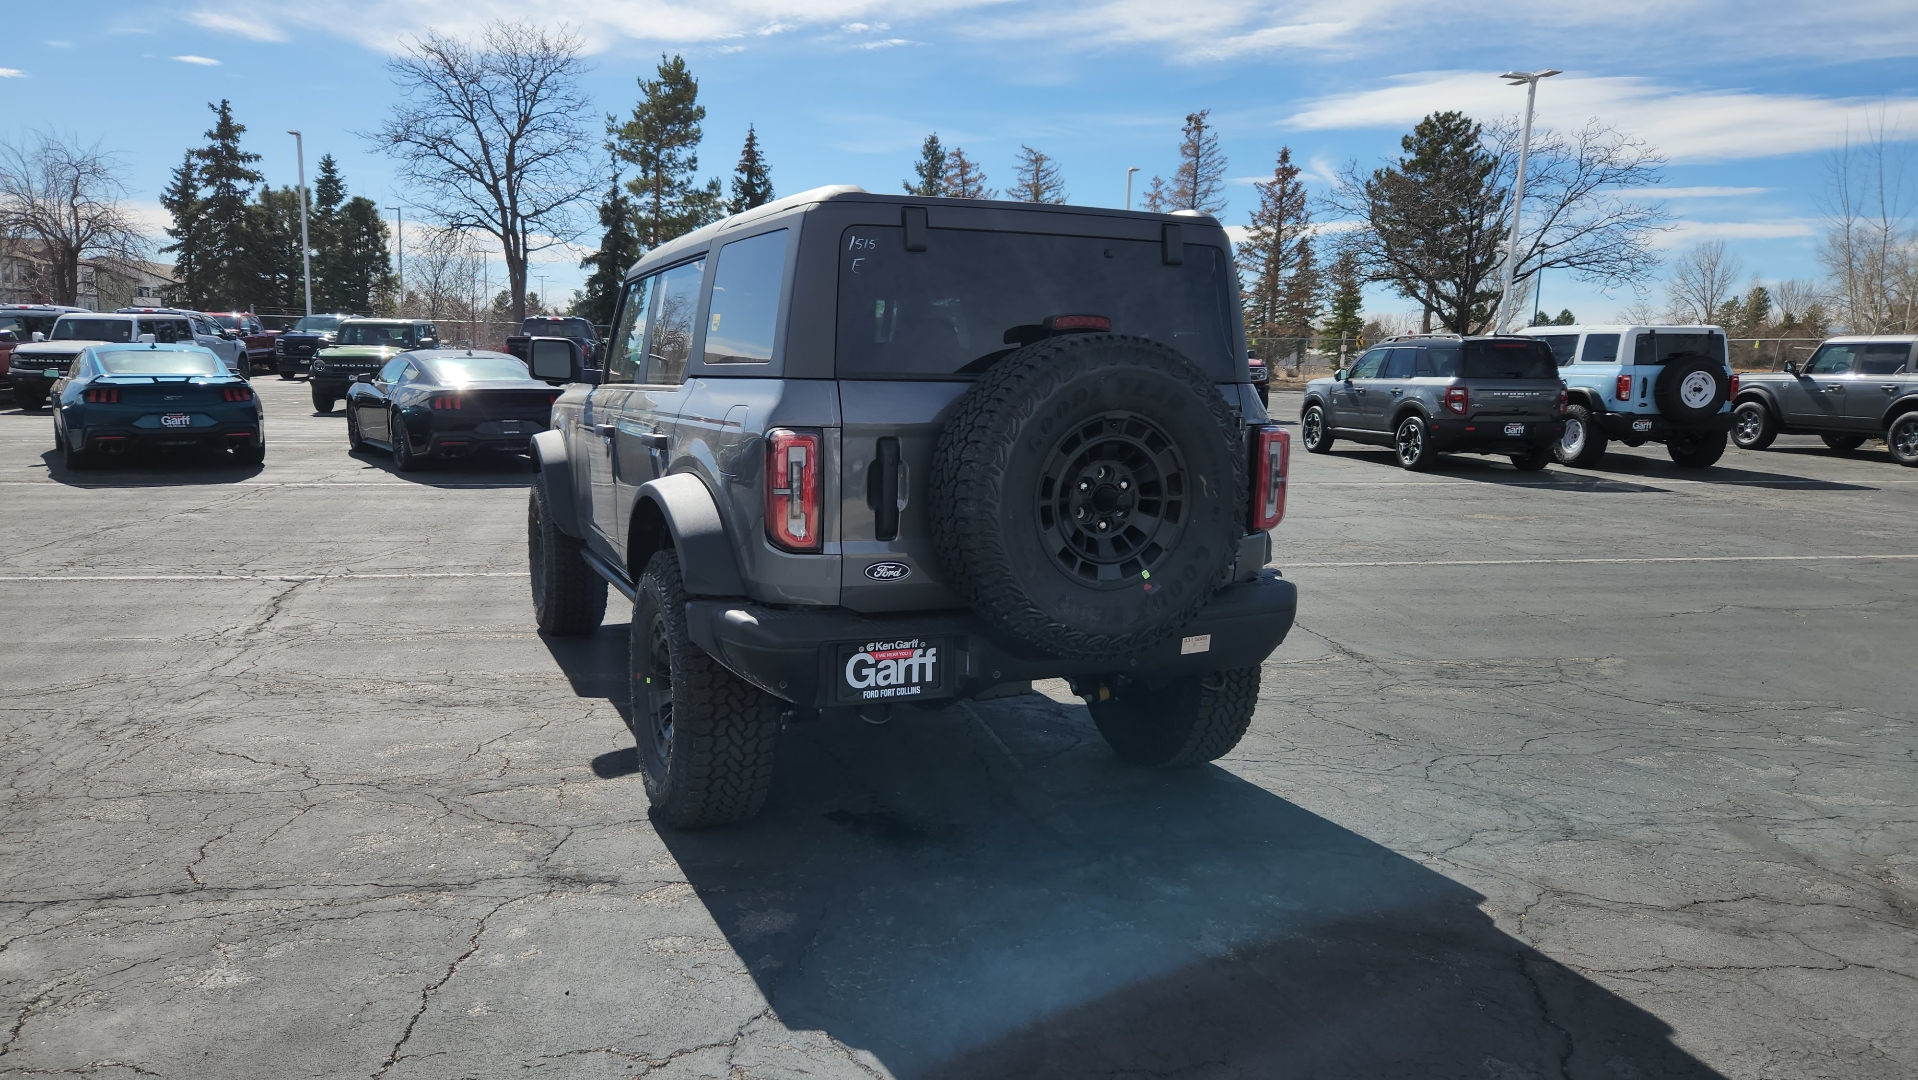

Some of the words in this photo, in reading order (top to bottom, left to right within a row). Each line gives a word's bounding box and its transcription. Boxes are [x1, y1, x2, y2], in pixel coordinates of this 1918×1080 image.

[160, 415, 190, 425] Garff
[1504, 425, 1524, 434] Garff
[873, 565, 902, 577] Ford
[875, 641, 895, 651] Ken
[895, 639, 918, 649] Garff
[845, 647, 937, 689] Garff
[863, 689, 879, 699] FORD
[880, 688, 895, 697] FORT
[896, 686, 920, 696] COLLINS
